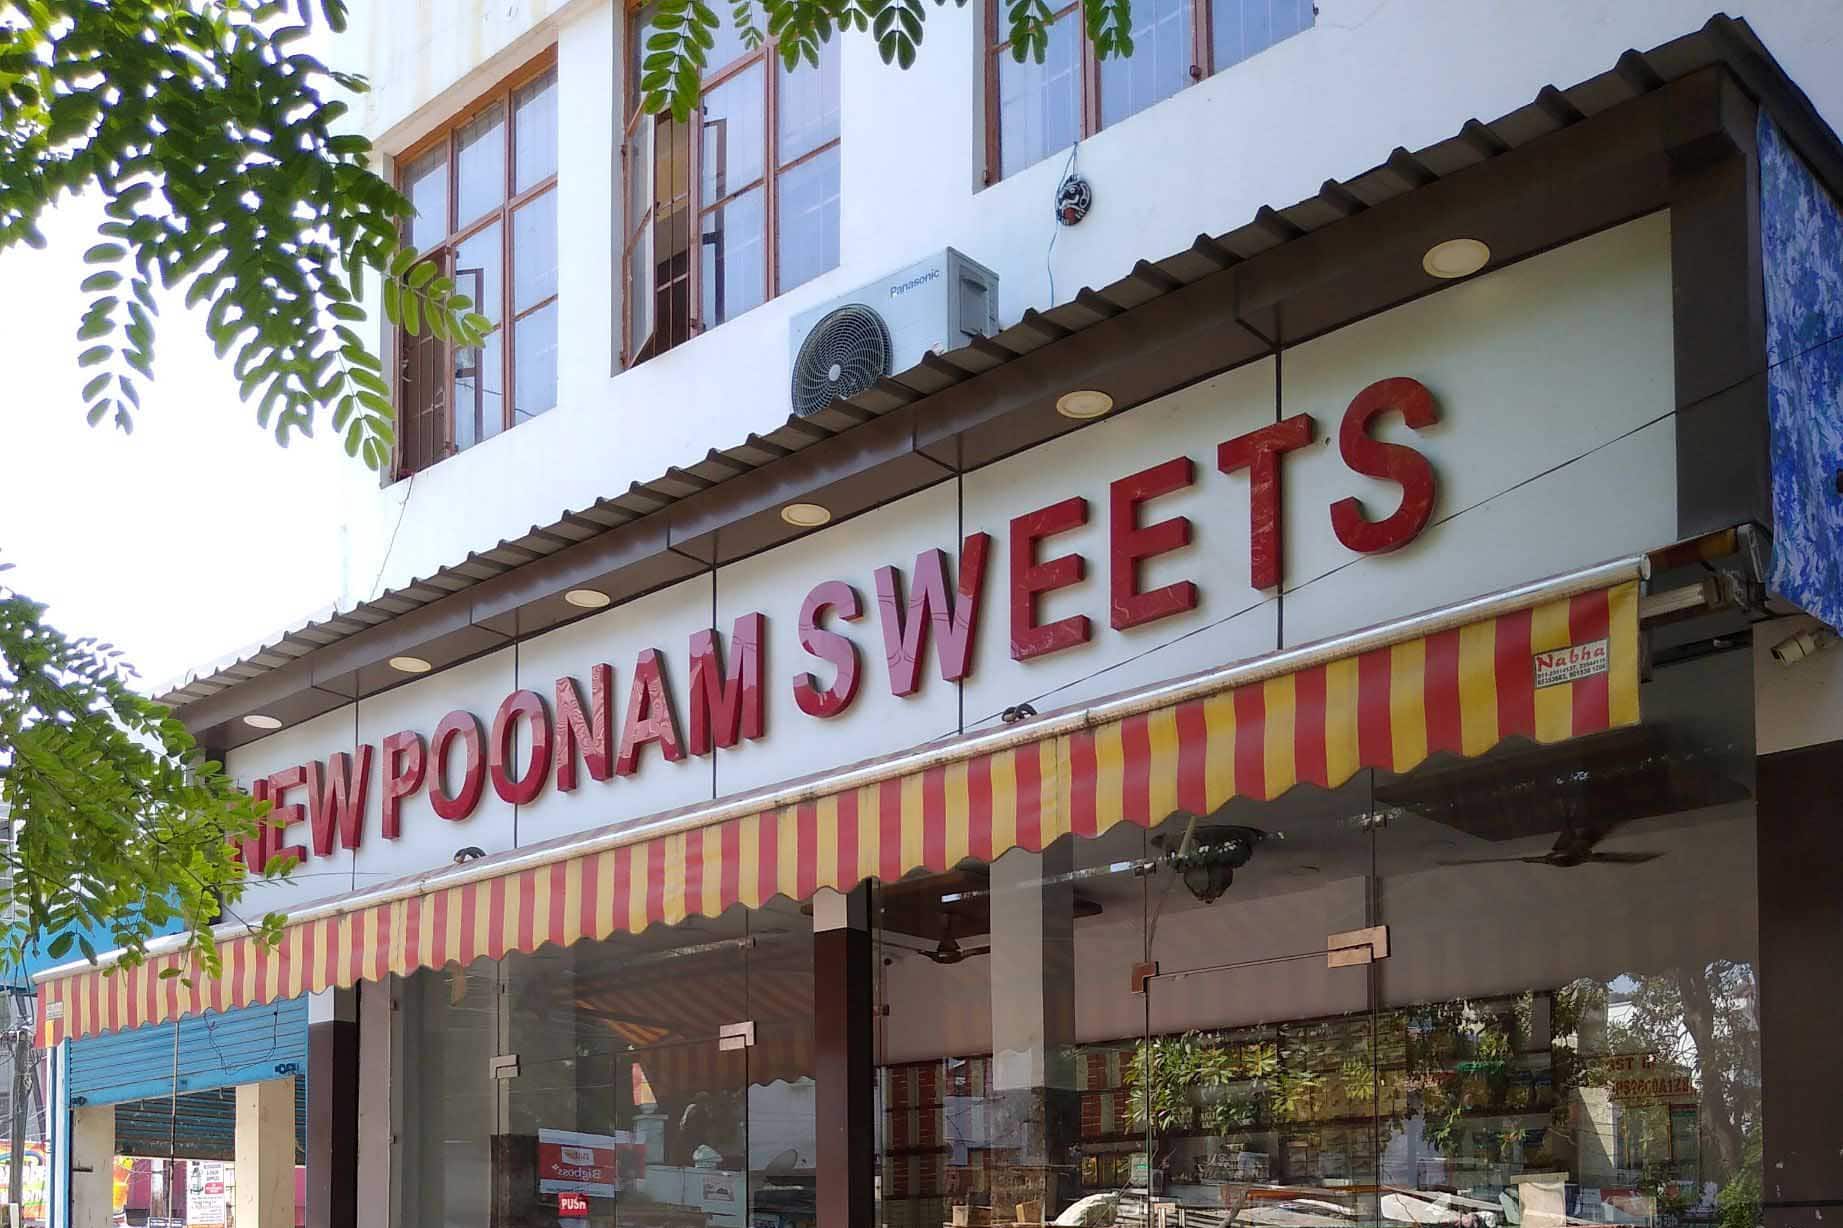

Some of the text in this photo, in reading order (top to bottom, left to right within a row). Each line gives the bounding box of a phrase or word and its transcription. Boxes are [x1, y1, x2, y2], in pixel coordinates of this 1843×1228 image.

[889, 268, 940, 298] Panasonic
[381, 611, 766, 841] POONAM
[792, 376, 1440, 719] SWEETS
[1536, 646, 1606, 673] Nabha
